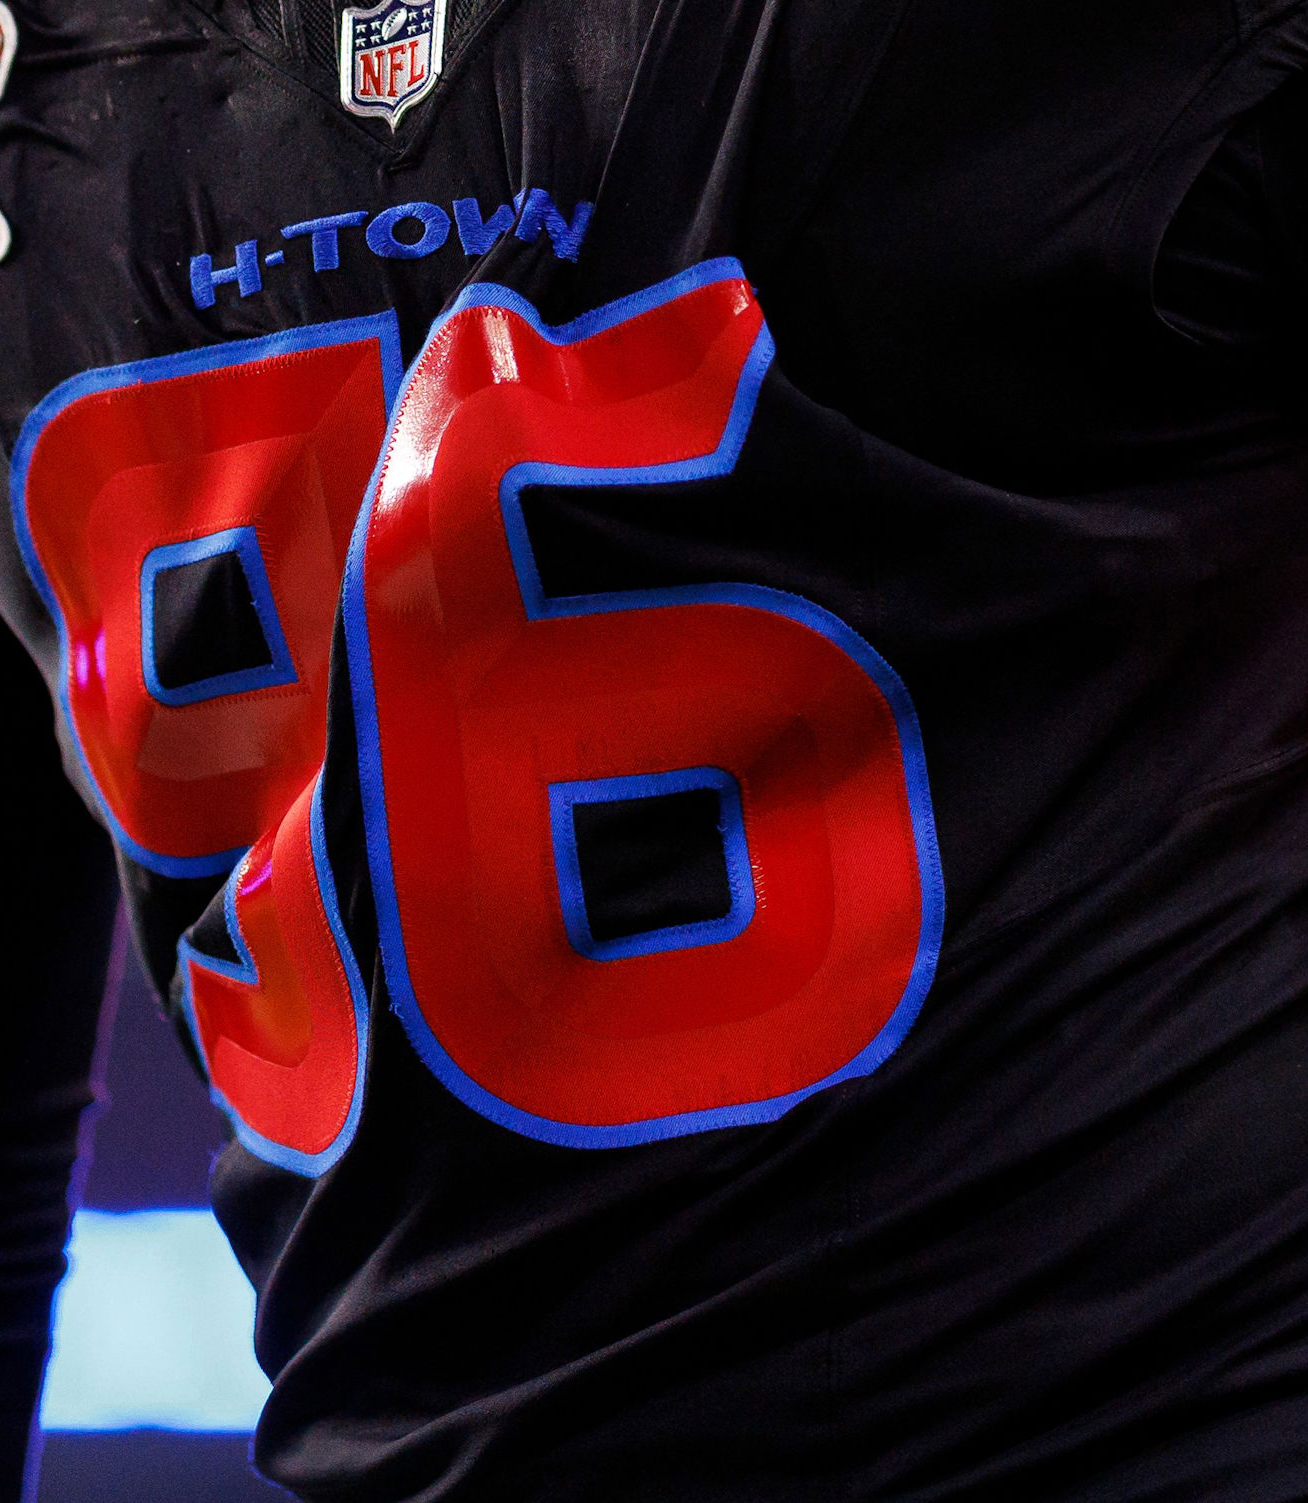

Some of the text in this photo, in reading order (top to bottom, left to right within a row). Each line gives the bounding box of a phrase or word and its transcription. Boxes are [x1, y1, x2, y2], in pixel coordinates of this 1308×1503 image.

[360, 40, 425, 97] NFL
[190, 187, 593, 310] H-TOWN
[10, 256, 945, 1177] 96
